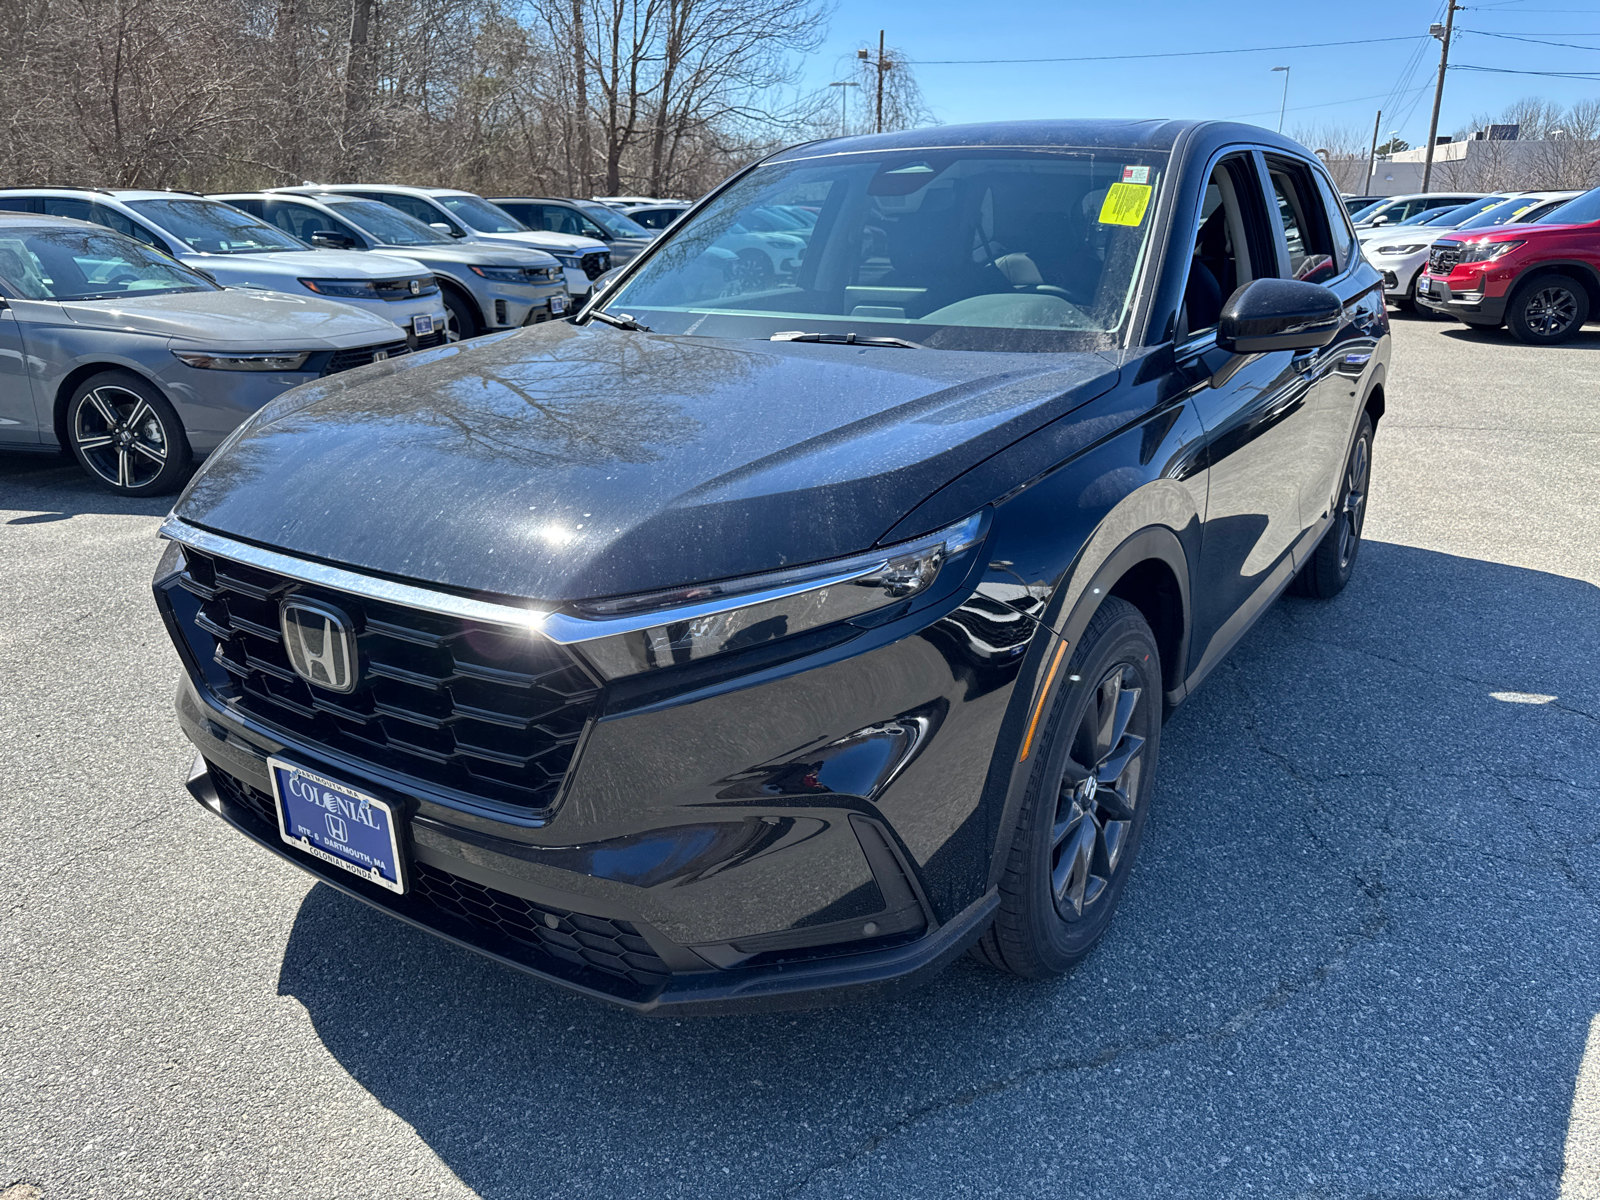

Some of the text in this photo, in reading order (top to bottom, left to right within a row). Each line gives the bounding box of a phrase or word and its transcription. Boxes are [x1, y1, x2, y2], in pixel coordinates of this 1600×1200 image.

[288, 778, 380, 830] COLONIAL
[314, 832, 320, 841] 6
[324, 836, 387, 870] DARTMOUTH, MA
[309, 846, 373, 881] COLONIAL HONDA
